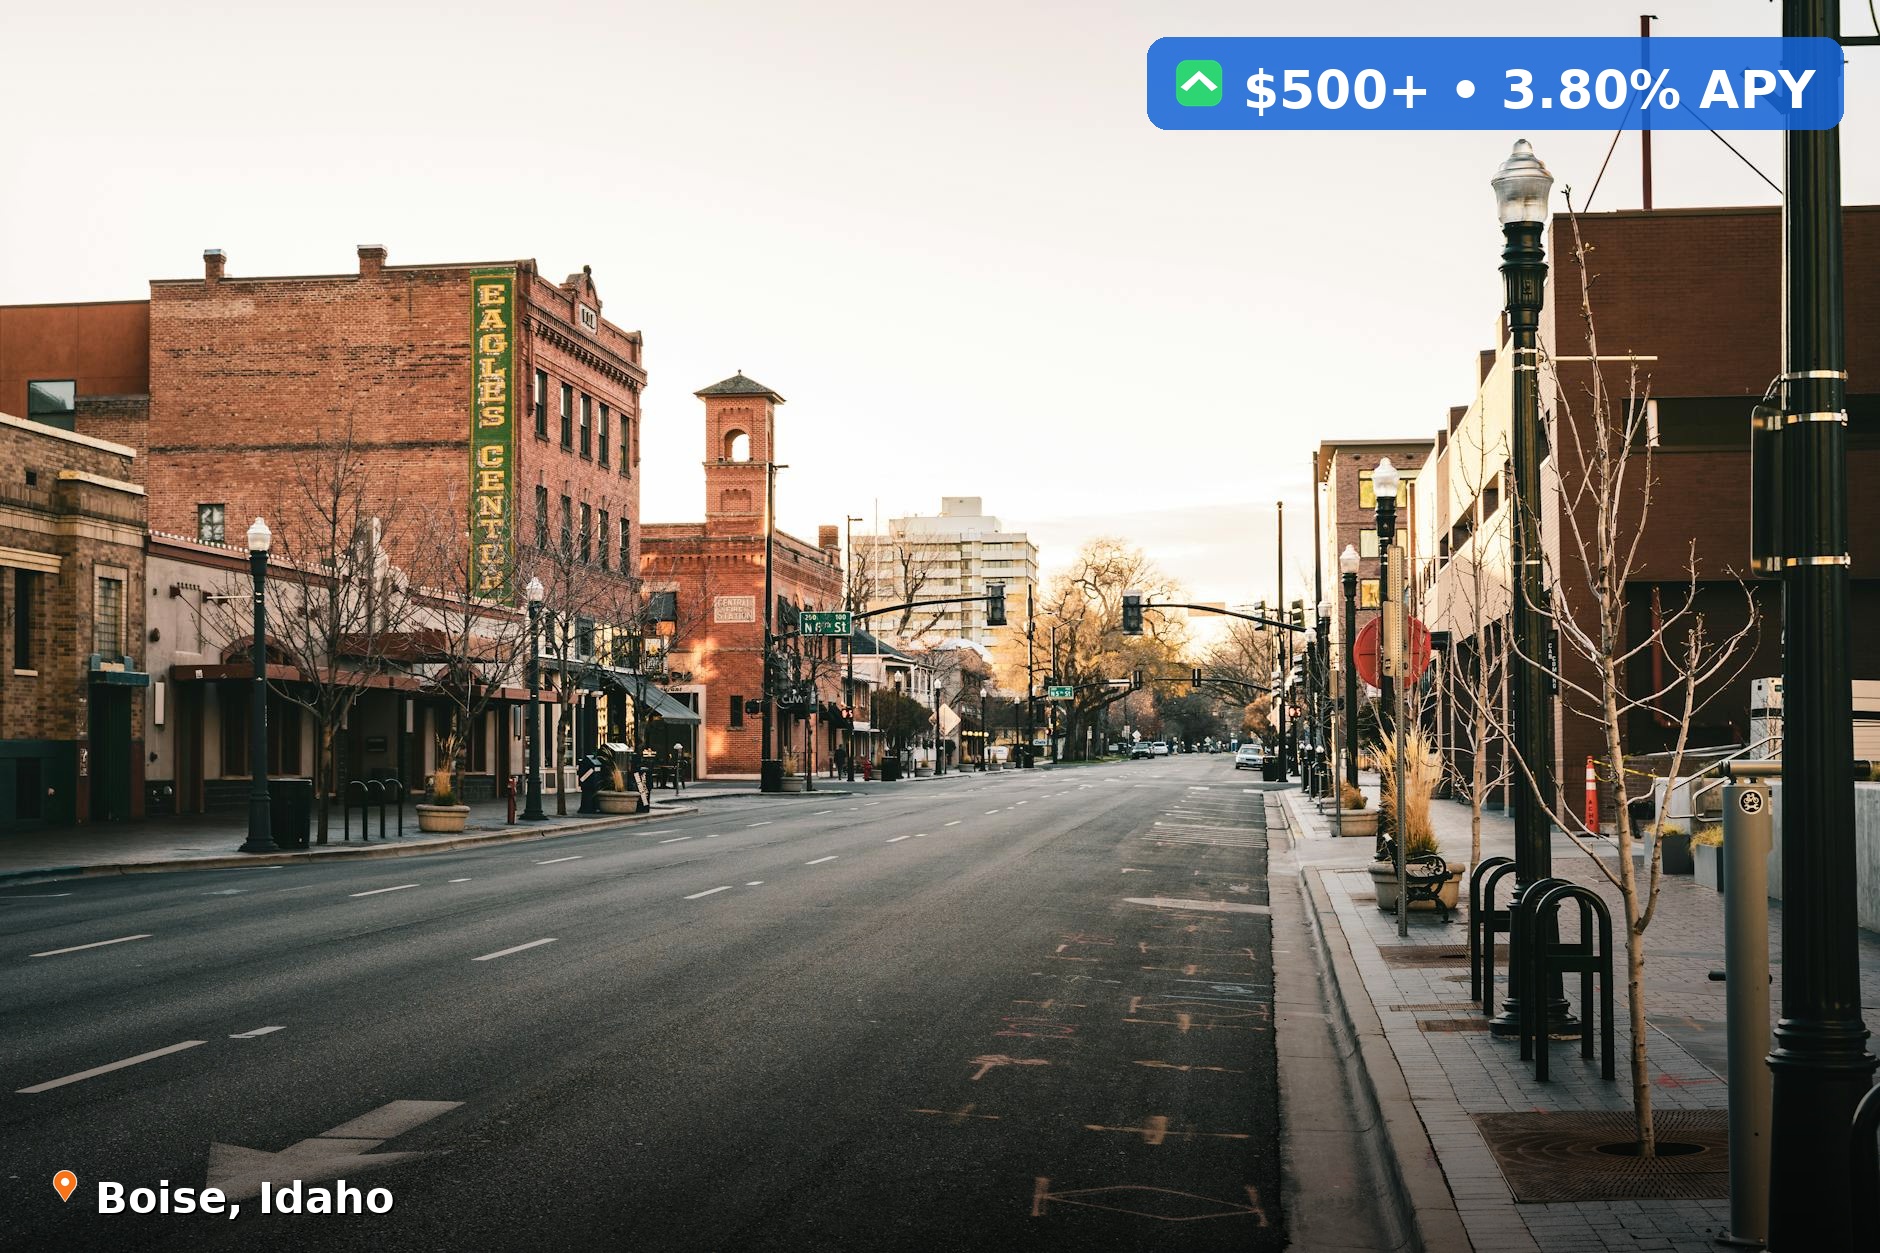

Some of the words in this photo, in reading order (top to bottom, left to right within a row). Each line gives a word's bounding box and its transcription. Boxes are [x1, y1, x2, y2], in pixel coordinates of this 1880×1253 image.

[478, 284, 508, 429] EAGLES
[717, 611, 753, 620] STATION
[804, 622, 813, 633] N
[834, 621, 847, 633] St
